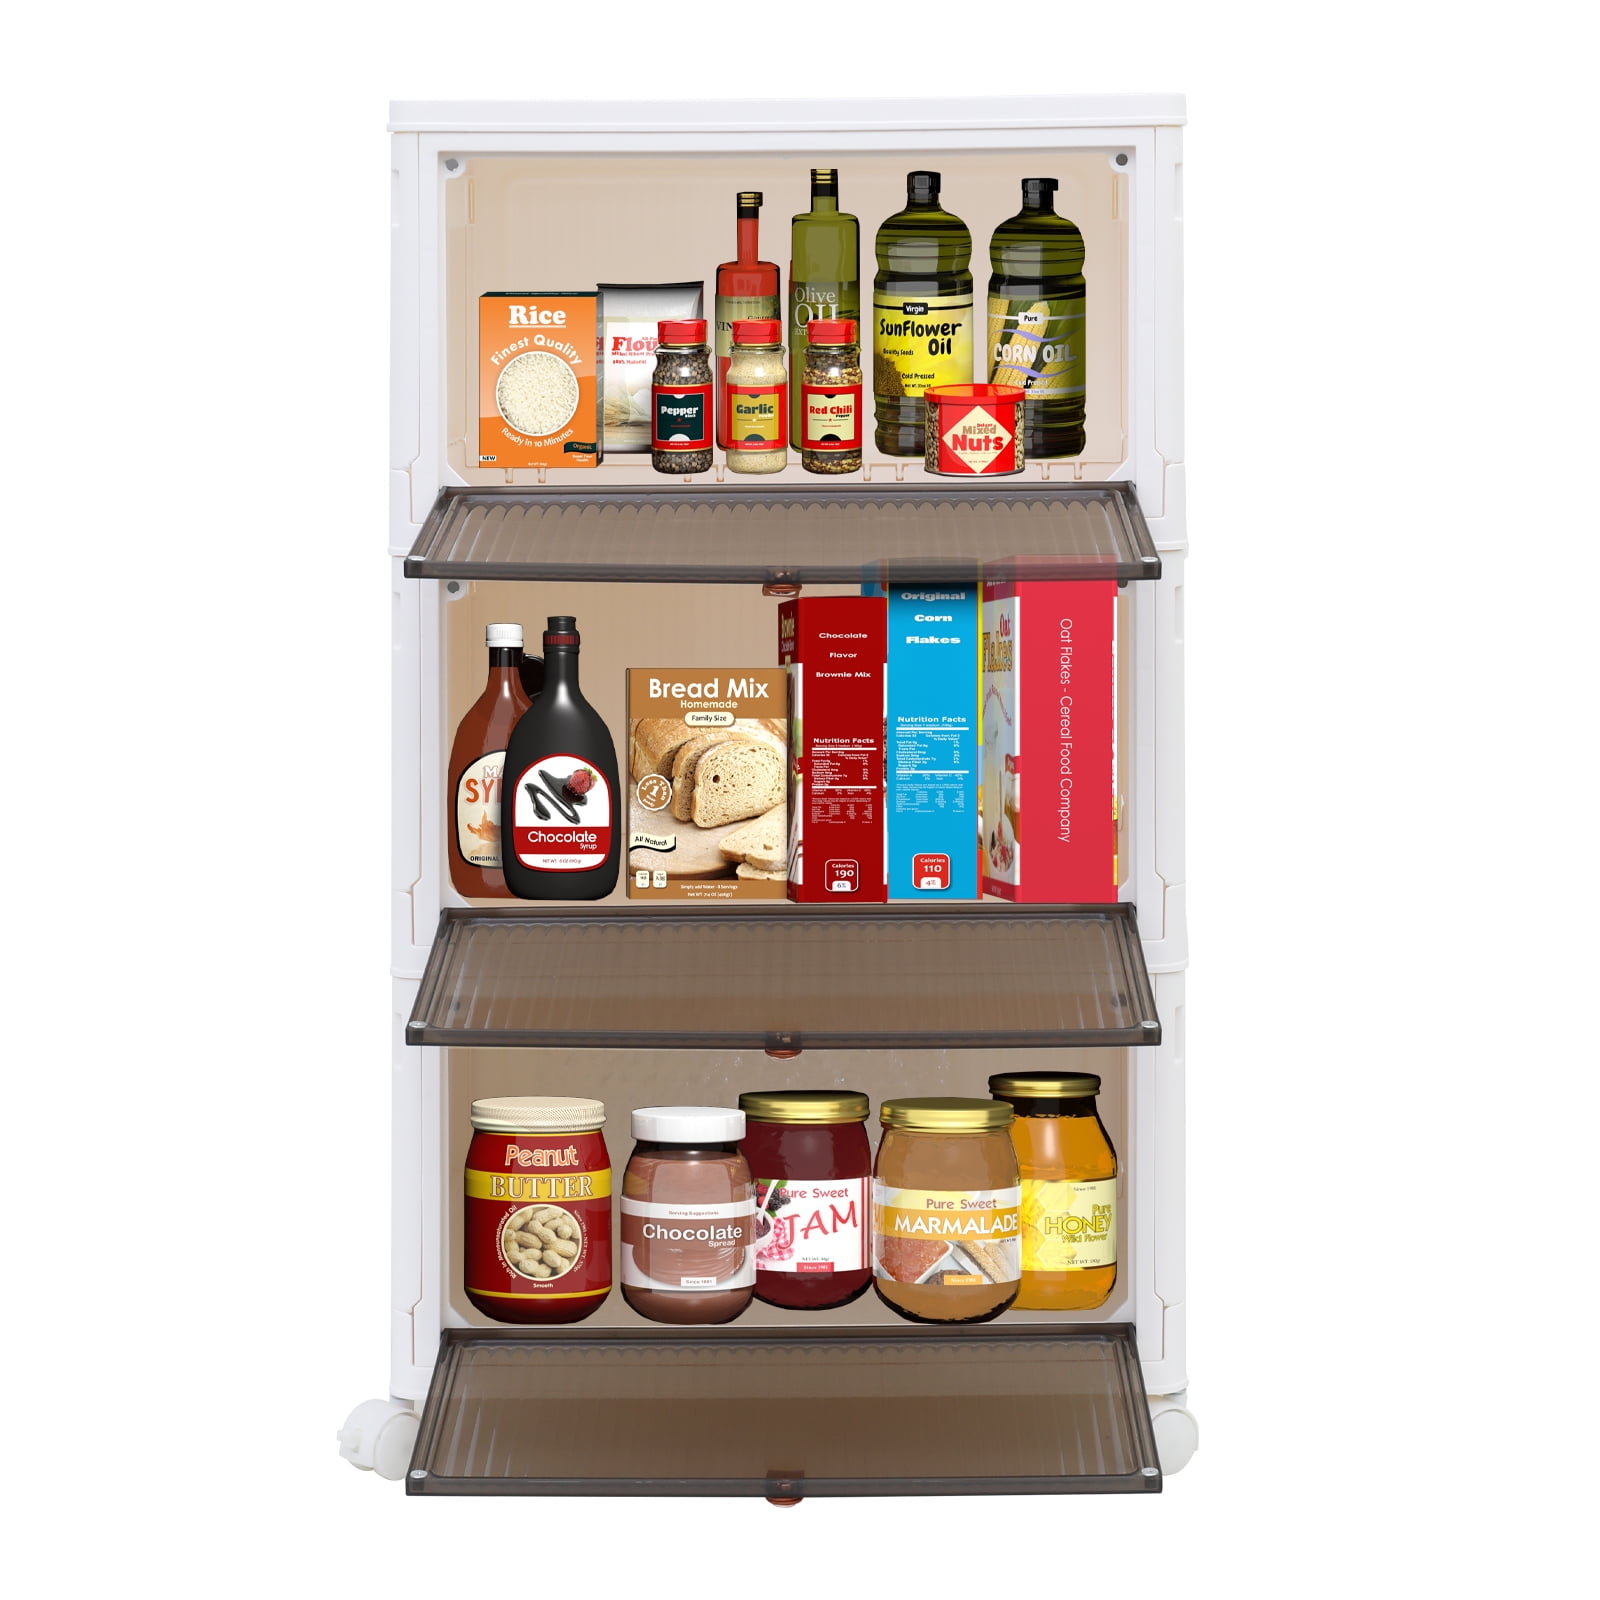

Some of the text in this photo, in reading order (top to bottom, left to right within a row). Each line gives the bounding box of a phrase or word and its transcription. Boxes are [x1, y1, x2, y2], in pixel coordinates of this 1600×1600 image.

[794, 287, 836, 303] Olive
[508, 305, 567, 325] Rice
[905, 305, 925, 314] Virgin
[879, 318, 963, 338] SunFlower
[490, 337, 529, 366] Finest
[533, 334, 583, 365] Quality
[611, 336, 658, 351] Flou
[927, 338, 952, 356] Oil
[993, 342, 1078, 363] CORN OIL
[660, 406, 699, 416] Pepper
[736, 404, 774, 415] Garlic
[809, 405, 853, 415] Red Chili
[501, 427, 524, 447] Ready
[524, 438, 533, 447] in
[543, 428, 574, 447] Minutes
[962, 424, 997, 435] Mixed
[952, 434, 1004, 451] Nuts
[901, 592, 966, 602] Original
[914, 614, 953, 622] Corn
[1000, 613, 1011, 638] Oat
[1060, 618, 1073, 643] Oat
[905, 636, 961, 644] Flakes
[982, 630, 1013, 673] Flakes
[1060, 647, 1073, 685] Flakes
[649, 678, 769, 698] Bread Mix
[680, 700, 738, 709] Homemade
[1059, 696, 1073, 739] Cereal
[1059, 743, 1073, 775] Food
[650, 785, 659, 797] 1
[1057, 778, 1073, 843] Company
[527, 831, 598, 843] Chocolate
[645, 836, 668, 846] Natural
[835, 870, 854, 879] 190
[504, 1144, 579, 1167] Peanut
[490, 1175, 593, 1198] BUTTER
[780, 1187, 849, 1198] Pure Sweet
[508, 1204, 518, 1214] Oil
[926, 1198, 997, 1209] Pure Sweet
[1092, 1203, 1112, 1215] Pure
[642, 1223, 743, 1240] Chocolate
[777, 1200, 858, 1249] JAM
[894, 1213, 1018, 1235] MARMALADE
[1044, 1213, 1113, 1235] HONEY
[708, 1240, 736, 1248] Spread
[1084, 1234, 1107, 1242] Flower
[506, 1266, 518, 1279] Rich
